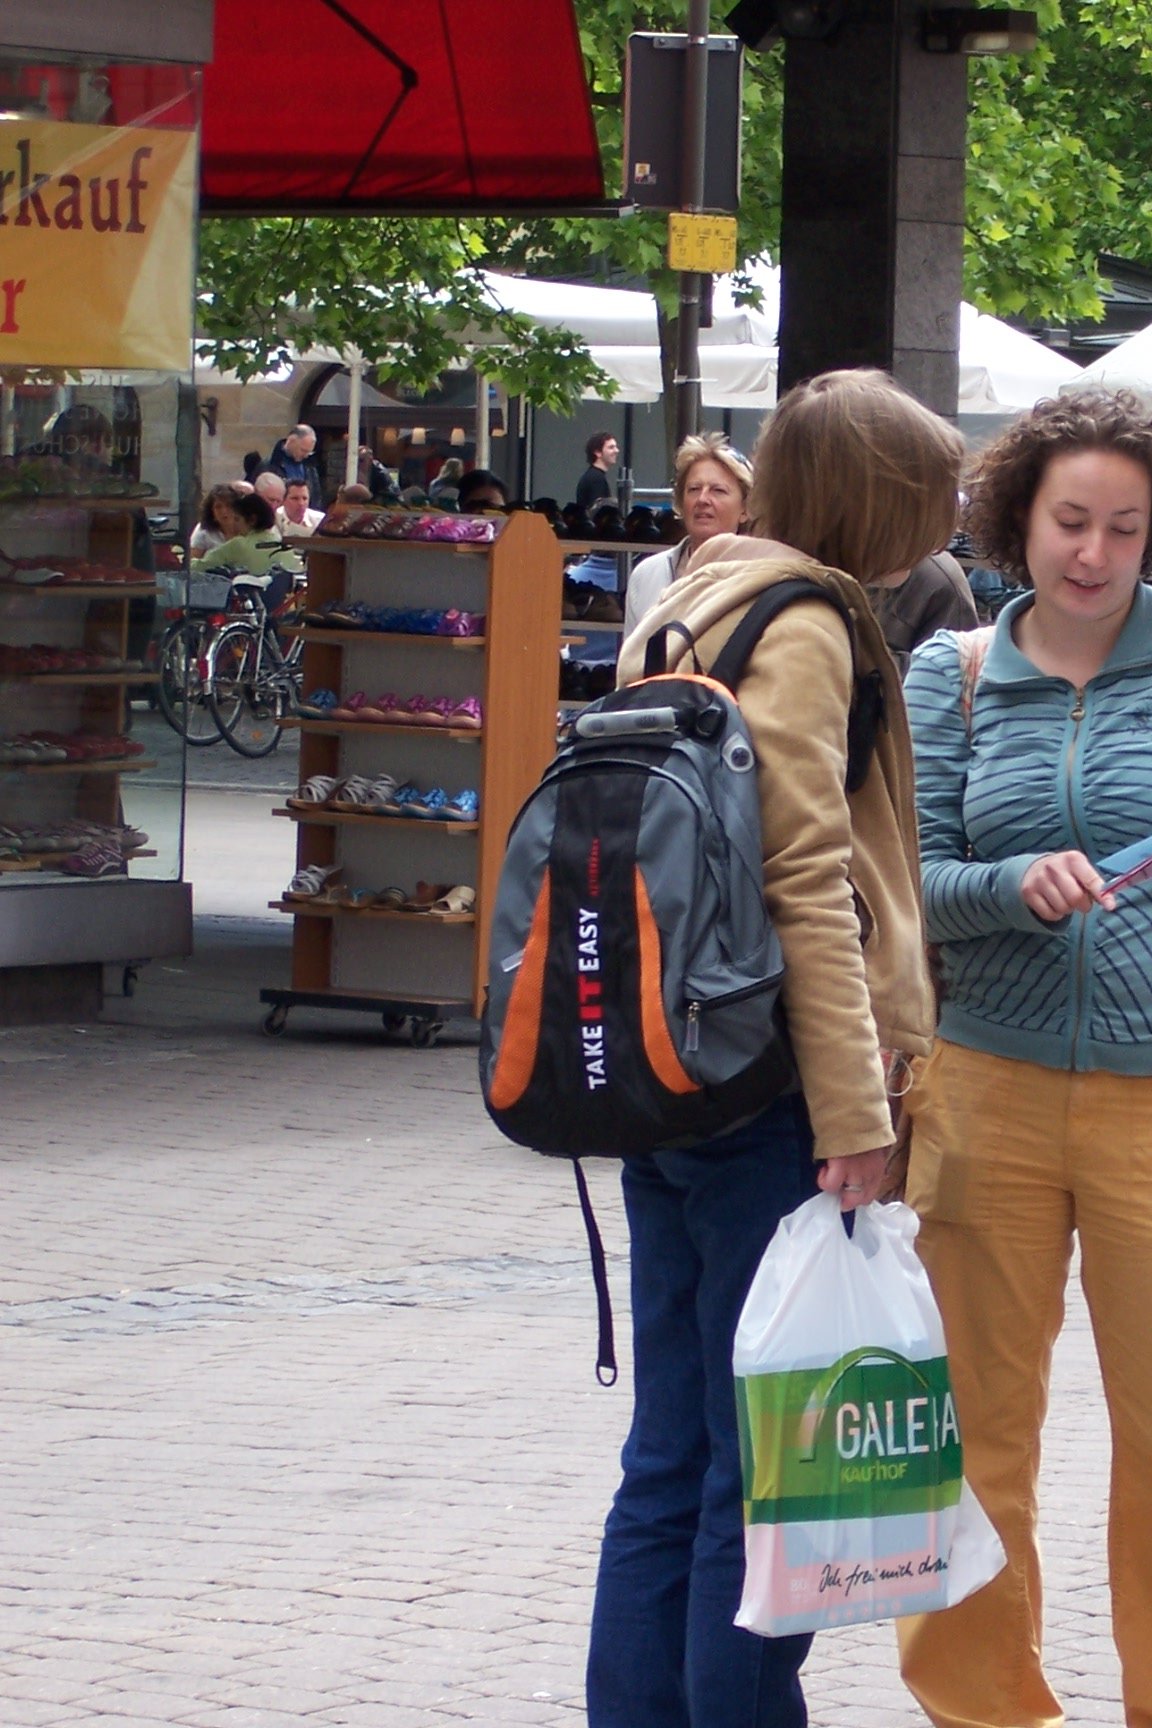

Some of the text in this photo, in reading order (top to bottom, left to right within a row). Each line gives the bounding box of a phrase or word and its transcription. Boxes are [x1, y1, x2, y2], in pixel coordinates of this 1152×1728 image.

[578, 907, 600, 972] EASY
[577, 975, 603, 1020] IT
[581, 1025, 607, 1090] TAKE
